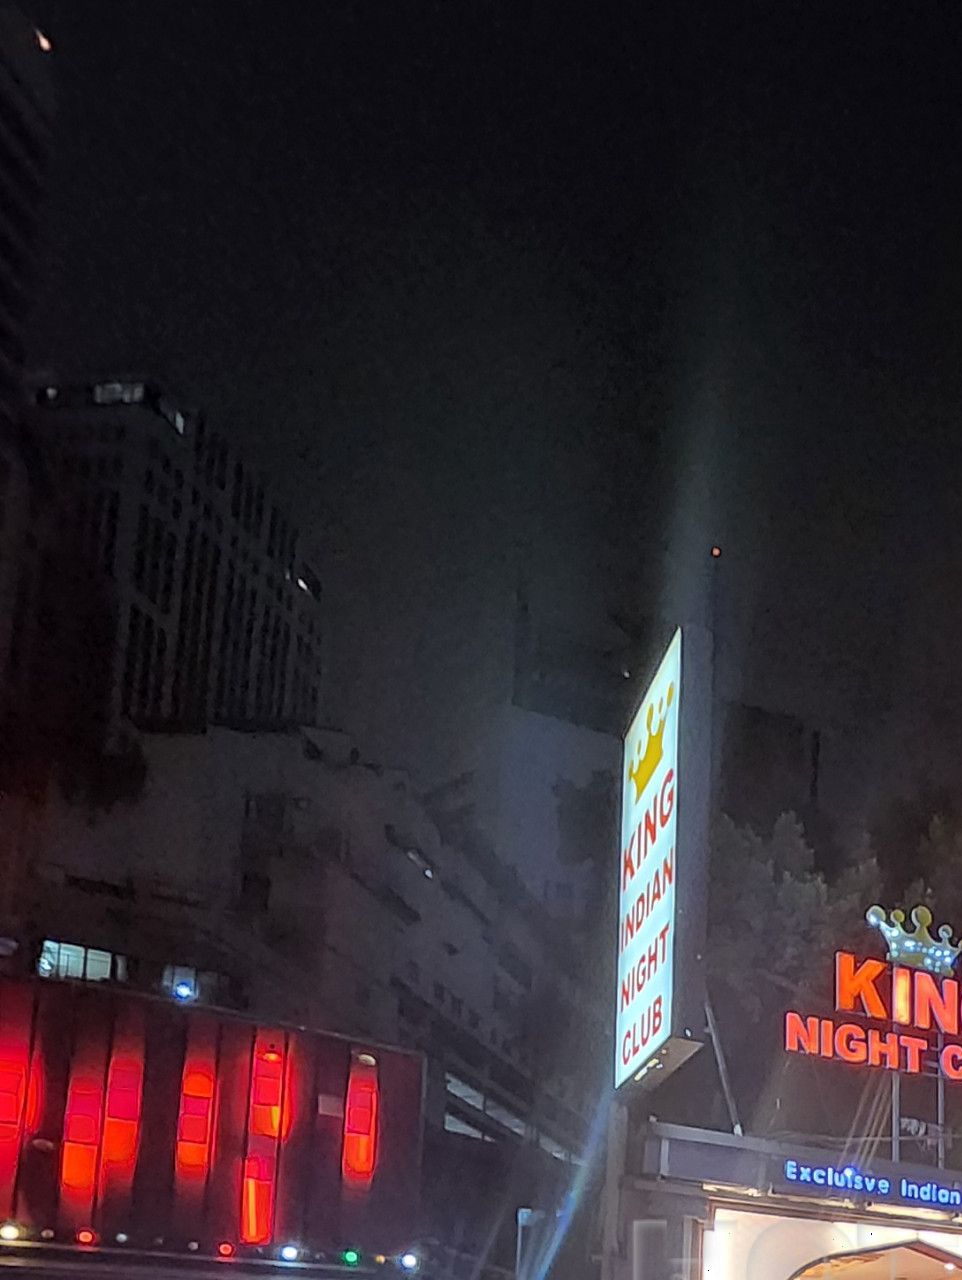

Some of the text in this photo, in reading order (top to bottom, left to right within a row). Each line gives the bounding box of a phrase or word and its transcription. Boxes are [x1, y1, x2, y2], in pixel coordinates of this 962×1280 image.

[622, 768, 674, 892] KING
[620, 847, 674, 954] INDIAN
[620, 921, 670, 1013] NIGHT
[622, 995, 663, 1066] CLUB
[785, 1012, 928, 1074] NIGHT
[901, 1178, 961, 1205] Indian
